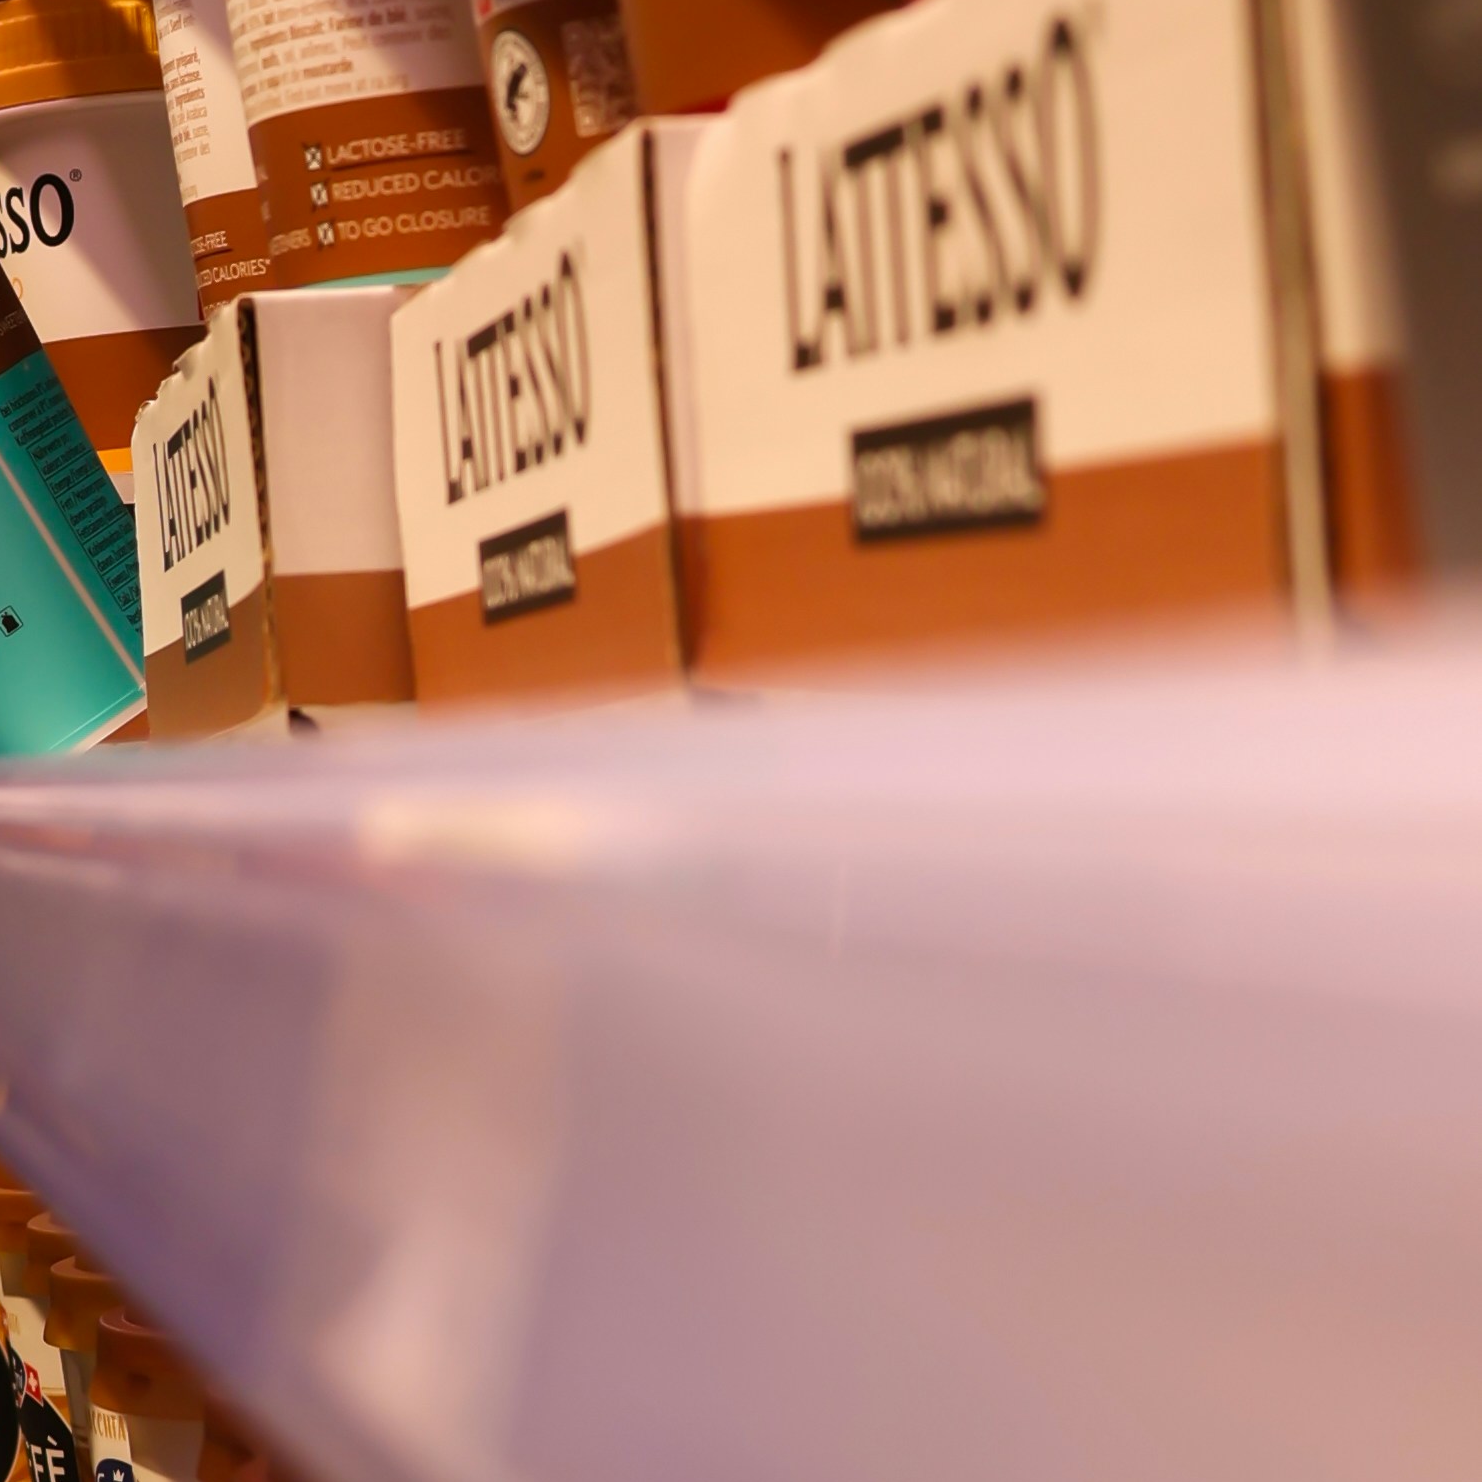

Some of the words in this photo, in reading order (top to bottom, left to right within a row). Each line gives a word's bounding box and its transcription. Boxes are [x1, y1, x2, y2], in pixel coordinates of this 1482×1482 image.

[326, 128, 466, 165] LACTOSE-FREE
[331, 171, 420, 202] REDUCED
[422, 166, 498, 190] CALOR
[775, 15, 1101, 373] LATTESSO
[337, 220, 361, 241] TO
[361, 215, 393, 238] GO
[394, 205, 491, 235] CLOSURE
[433, 251, 593, 504] LATTESSO
[153, 373, 230, 574] LATTESSO
